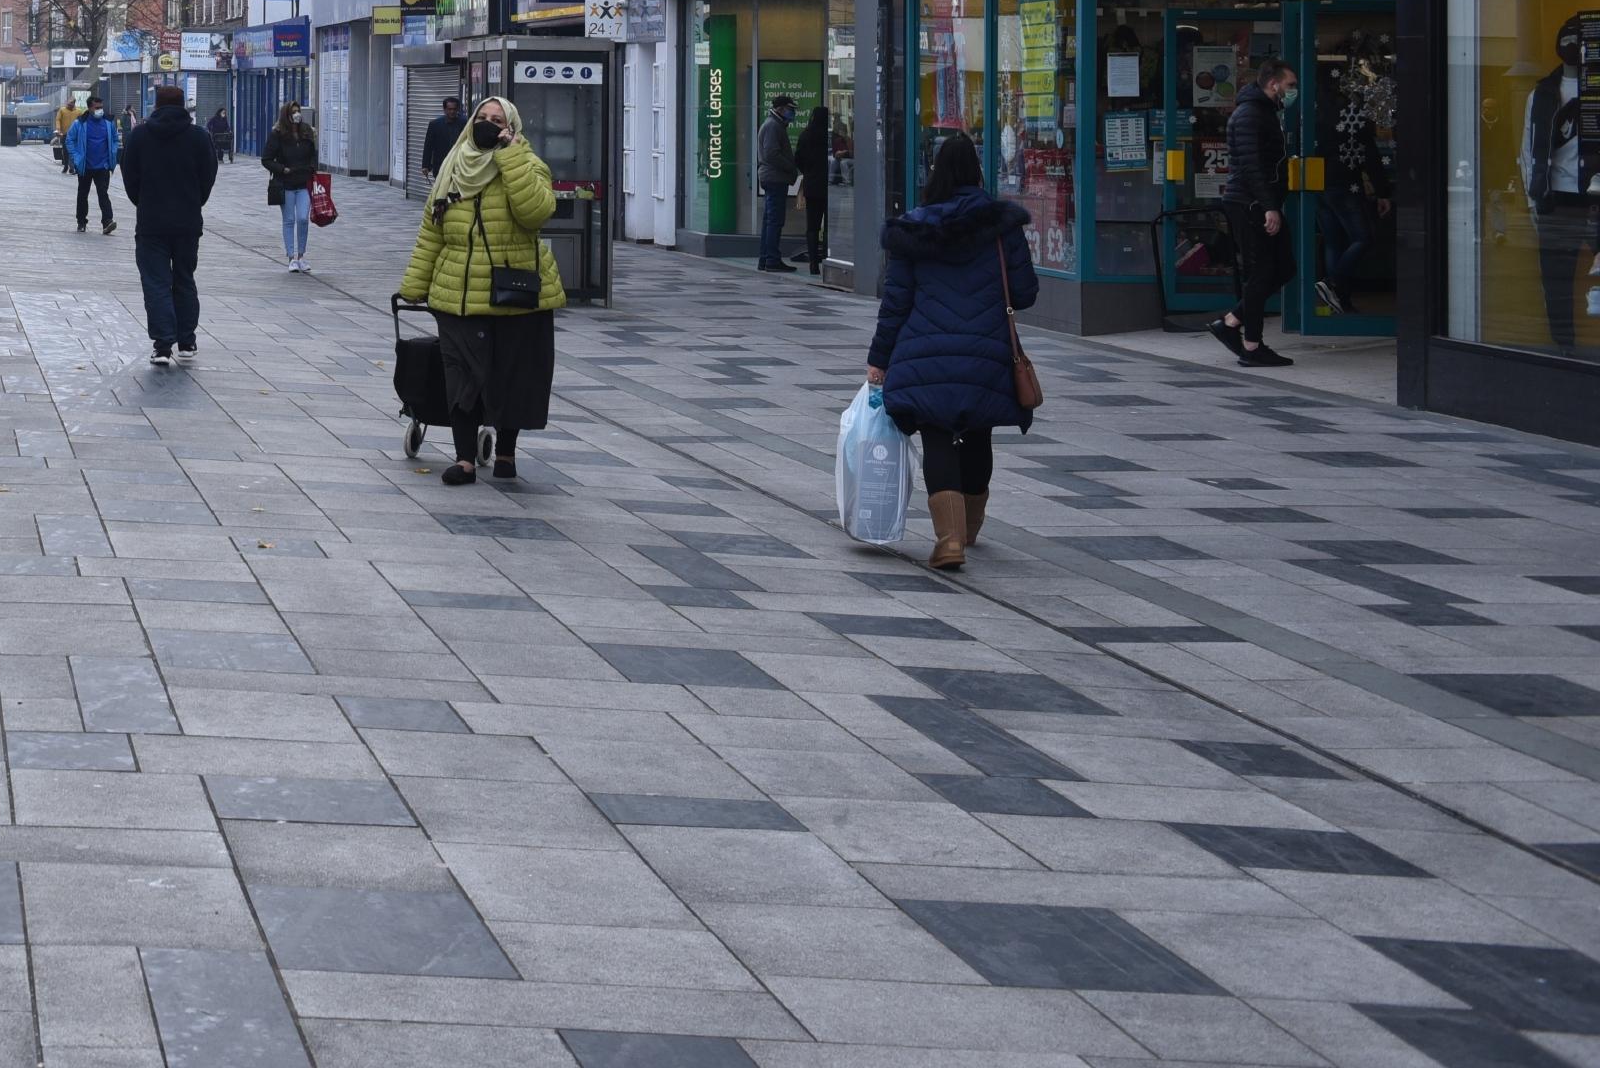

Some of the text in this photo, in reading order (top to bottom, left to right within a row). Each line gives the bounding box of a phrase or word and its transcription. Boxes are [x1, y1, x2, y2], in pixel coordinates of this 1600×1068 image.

[589, 22, 623, 35] 24:7
[764, 81, 786, 89] Can't
[785, 91, 817, 99] regular
[706, 68, 722, 178] Contact Lenses
[1204, 149, 1229, 169] 25
